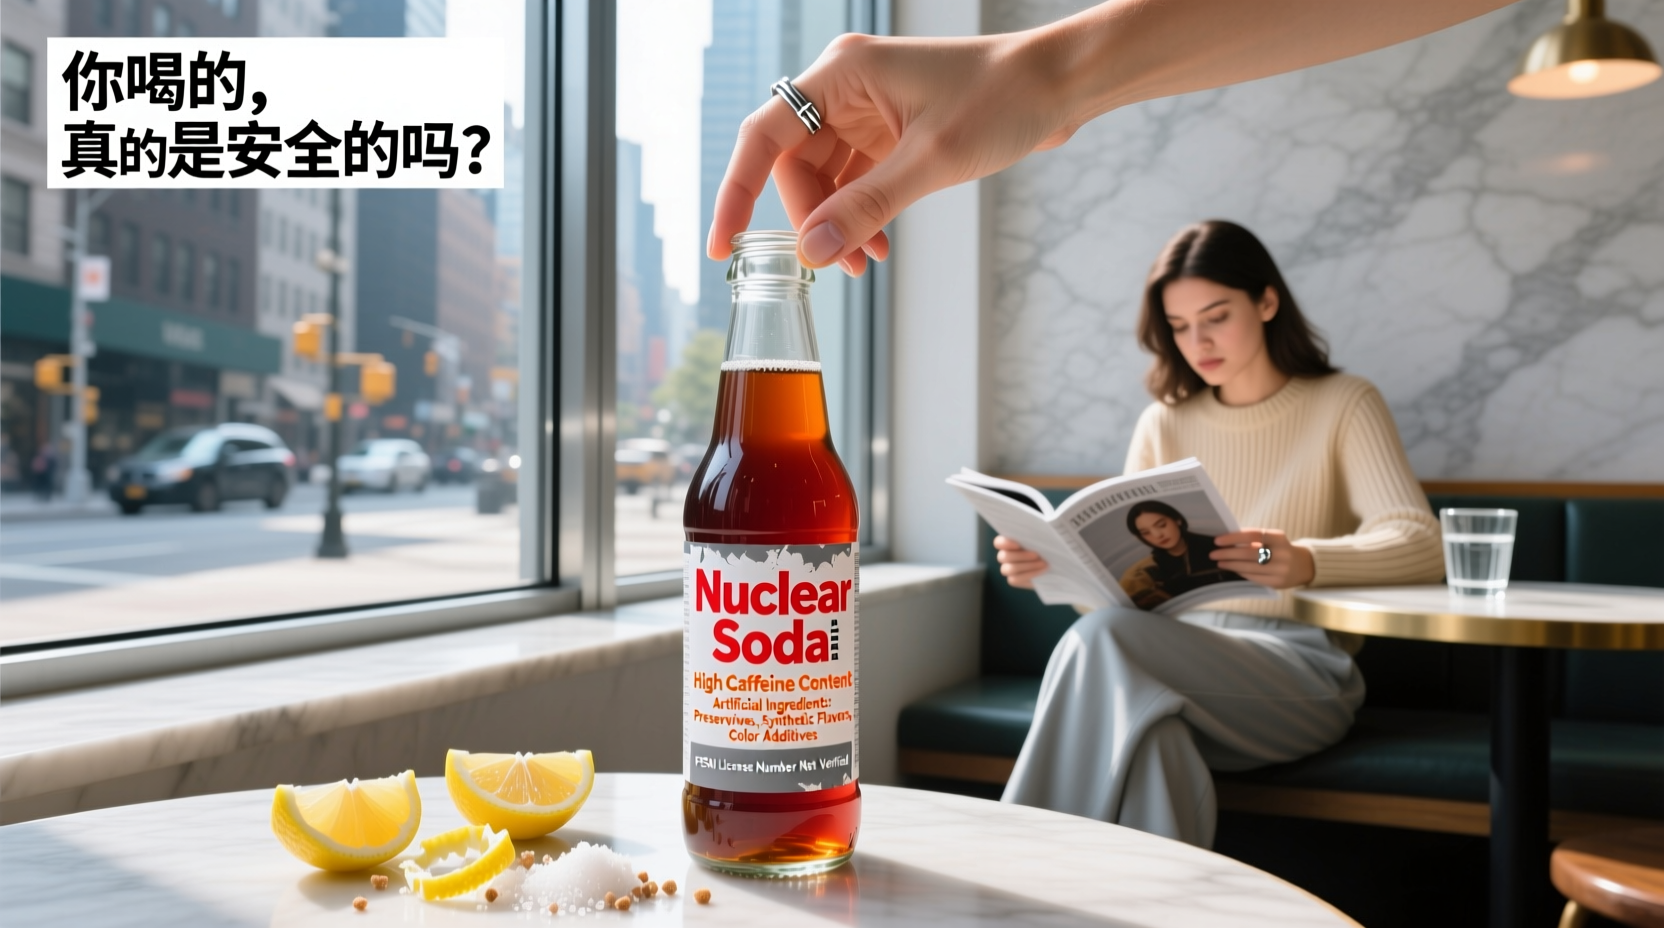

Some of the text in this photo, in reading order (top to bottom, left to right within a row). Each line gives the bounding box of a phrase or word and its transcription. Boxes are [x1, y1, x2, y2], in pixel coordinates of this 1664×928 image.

[696, 568, 852, 616] Nuclear
[712, 618, 829, 665] Soda
[694, 670, 852, 694] High Caffeine Content
[713, 697, 762, 711] Artificial
[728, 728, 818, 742] Color Additives
